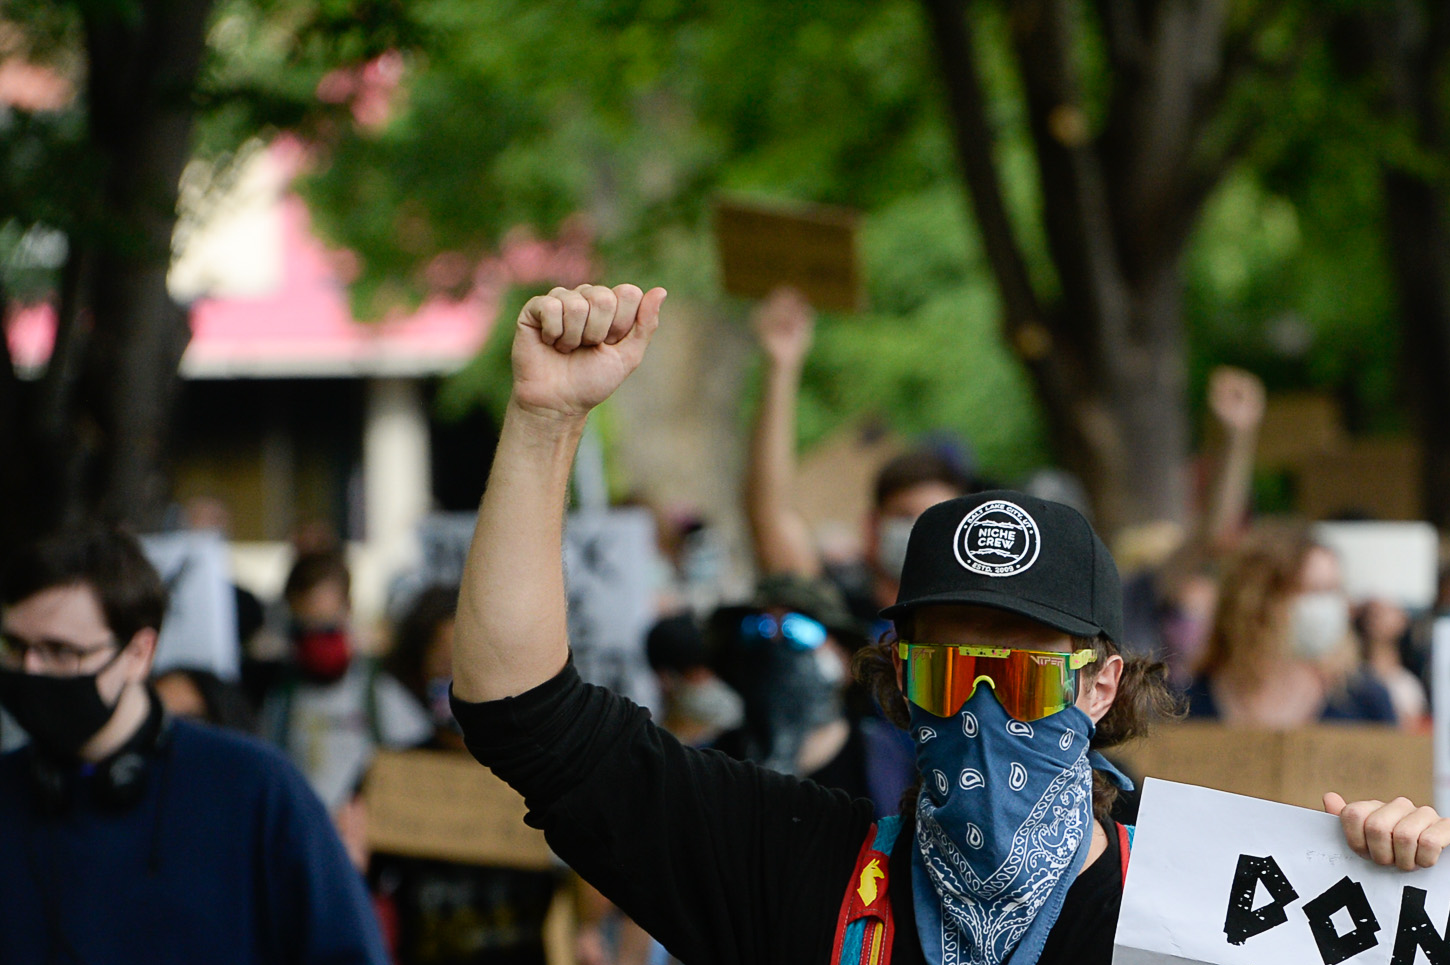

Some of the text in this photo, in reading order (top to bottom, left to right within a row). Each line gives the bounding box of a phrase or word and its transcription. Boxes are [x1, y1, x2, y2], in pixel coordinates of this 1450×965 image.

[1022, 519, 1033, 529] UT
[978, 528, 1016, 541] NICHE
[977, 537, 1015, 550] CREW
